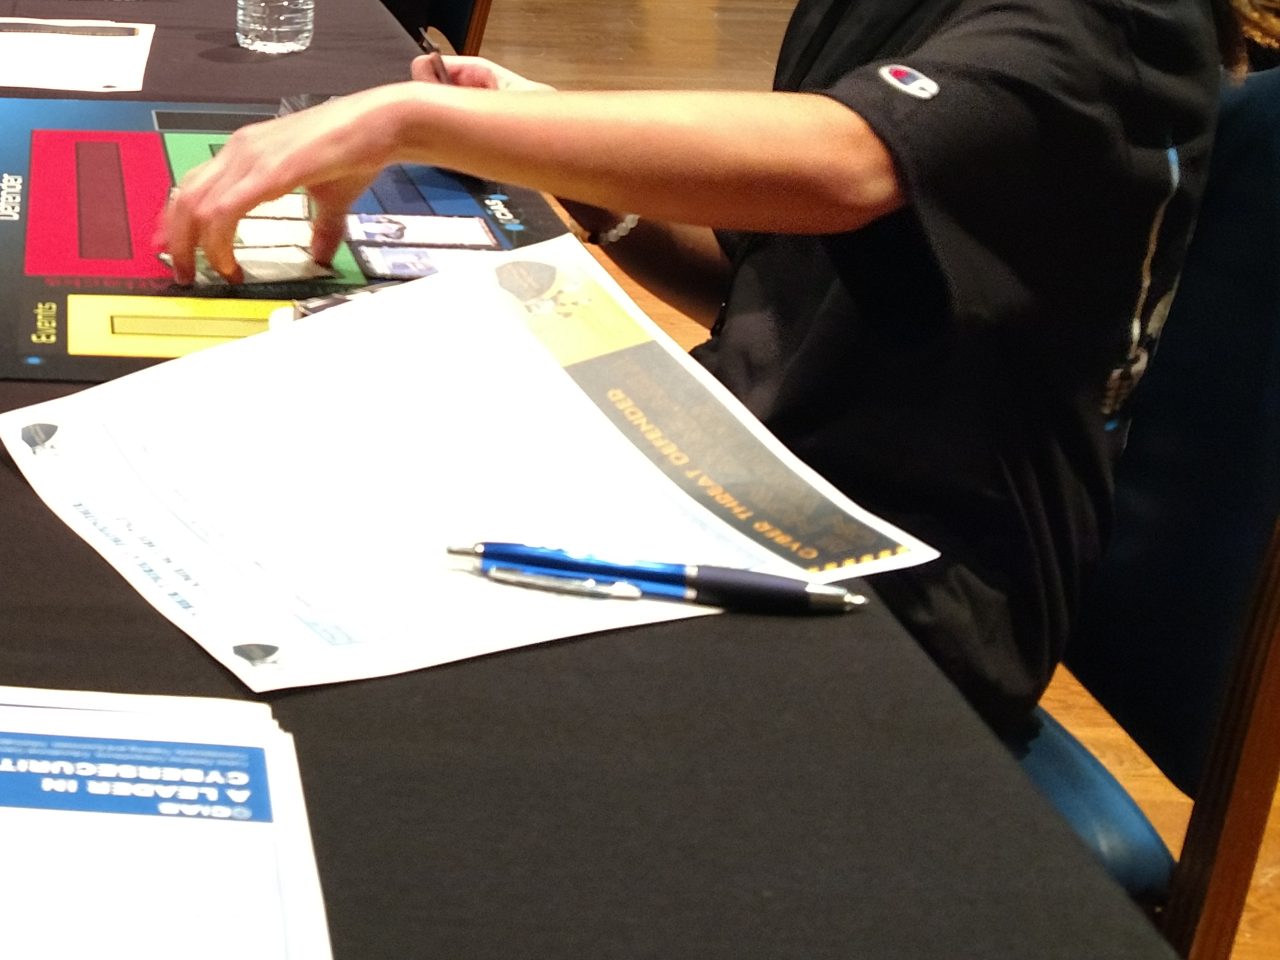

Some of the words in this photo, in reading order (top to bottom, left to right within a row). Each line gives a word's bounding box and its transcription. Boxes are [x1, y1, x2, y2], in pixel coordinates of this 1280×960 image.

[31, 302, 57, 344] Events
[607, 388, 690, 466] DEFENDER
[685, 469, 754, 521] THREAT
[40, 777, 78, 794] IN
[86, 780, 219, 801] LEADER
[226, 789, 252, 803] A
